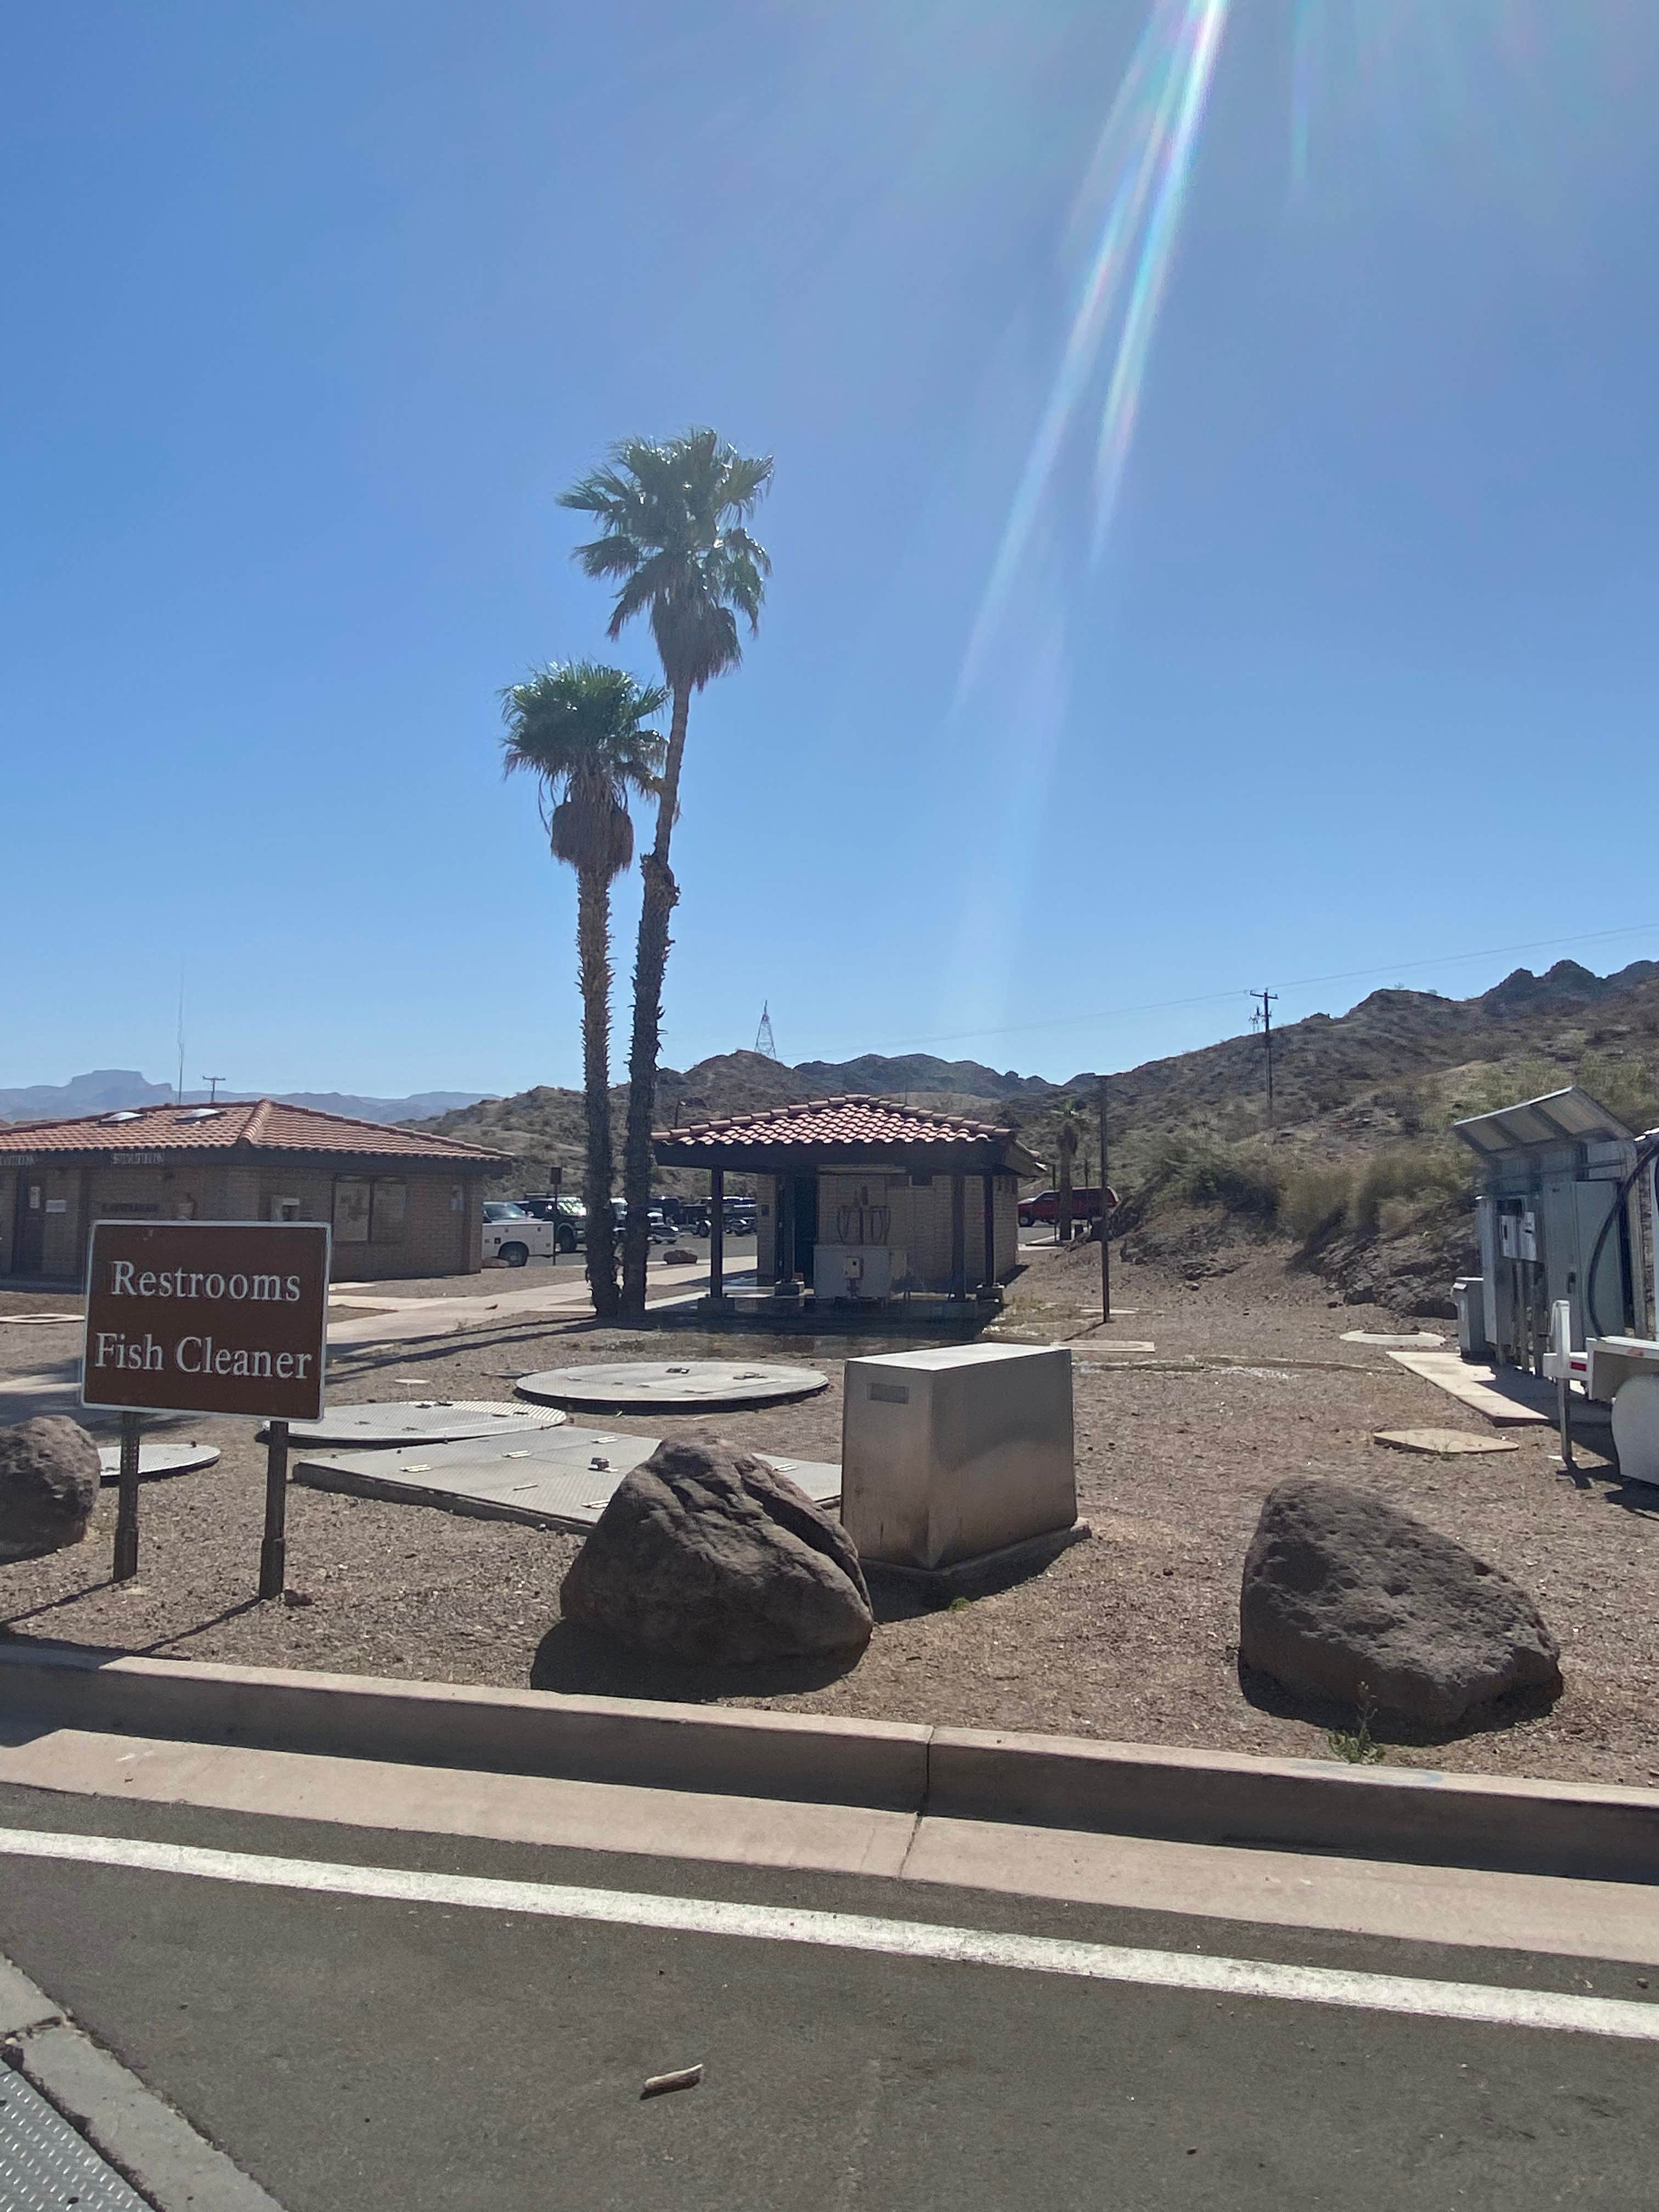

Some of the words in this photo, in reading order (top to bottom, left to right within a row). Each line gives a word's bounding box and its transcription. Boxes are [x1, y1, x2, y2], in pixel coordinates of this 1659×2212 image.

[111, 1261, 300, 1301] Restrooms
[95, 1333, 163, 1370] Fish
[176, 1336, 312, 1379] Cleaner
